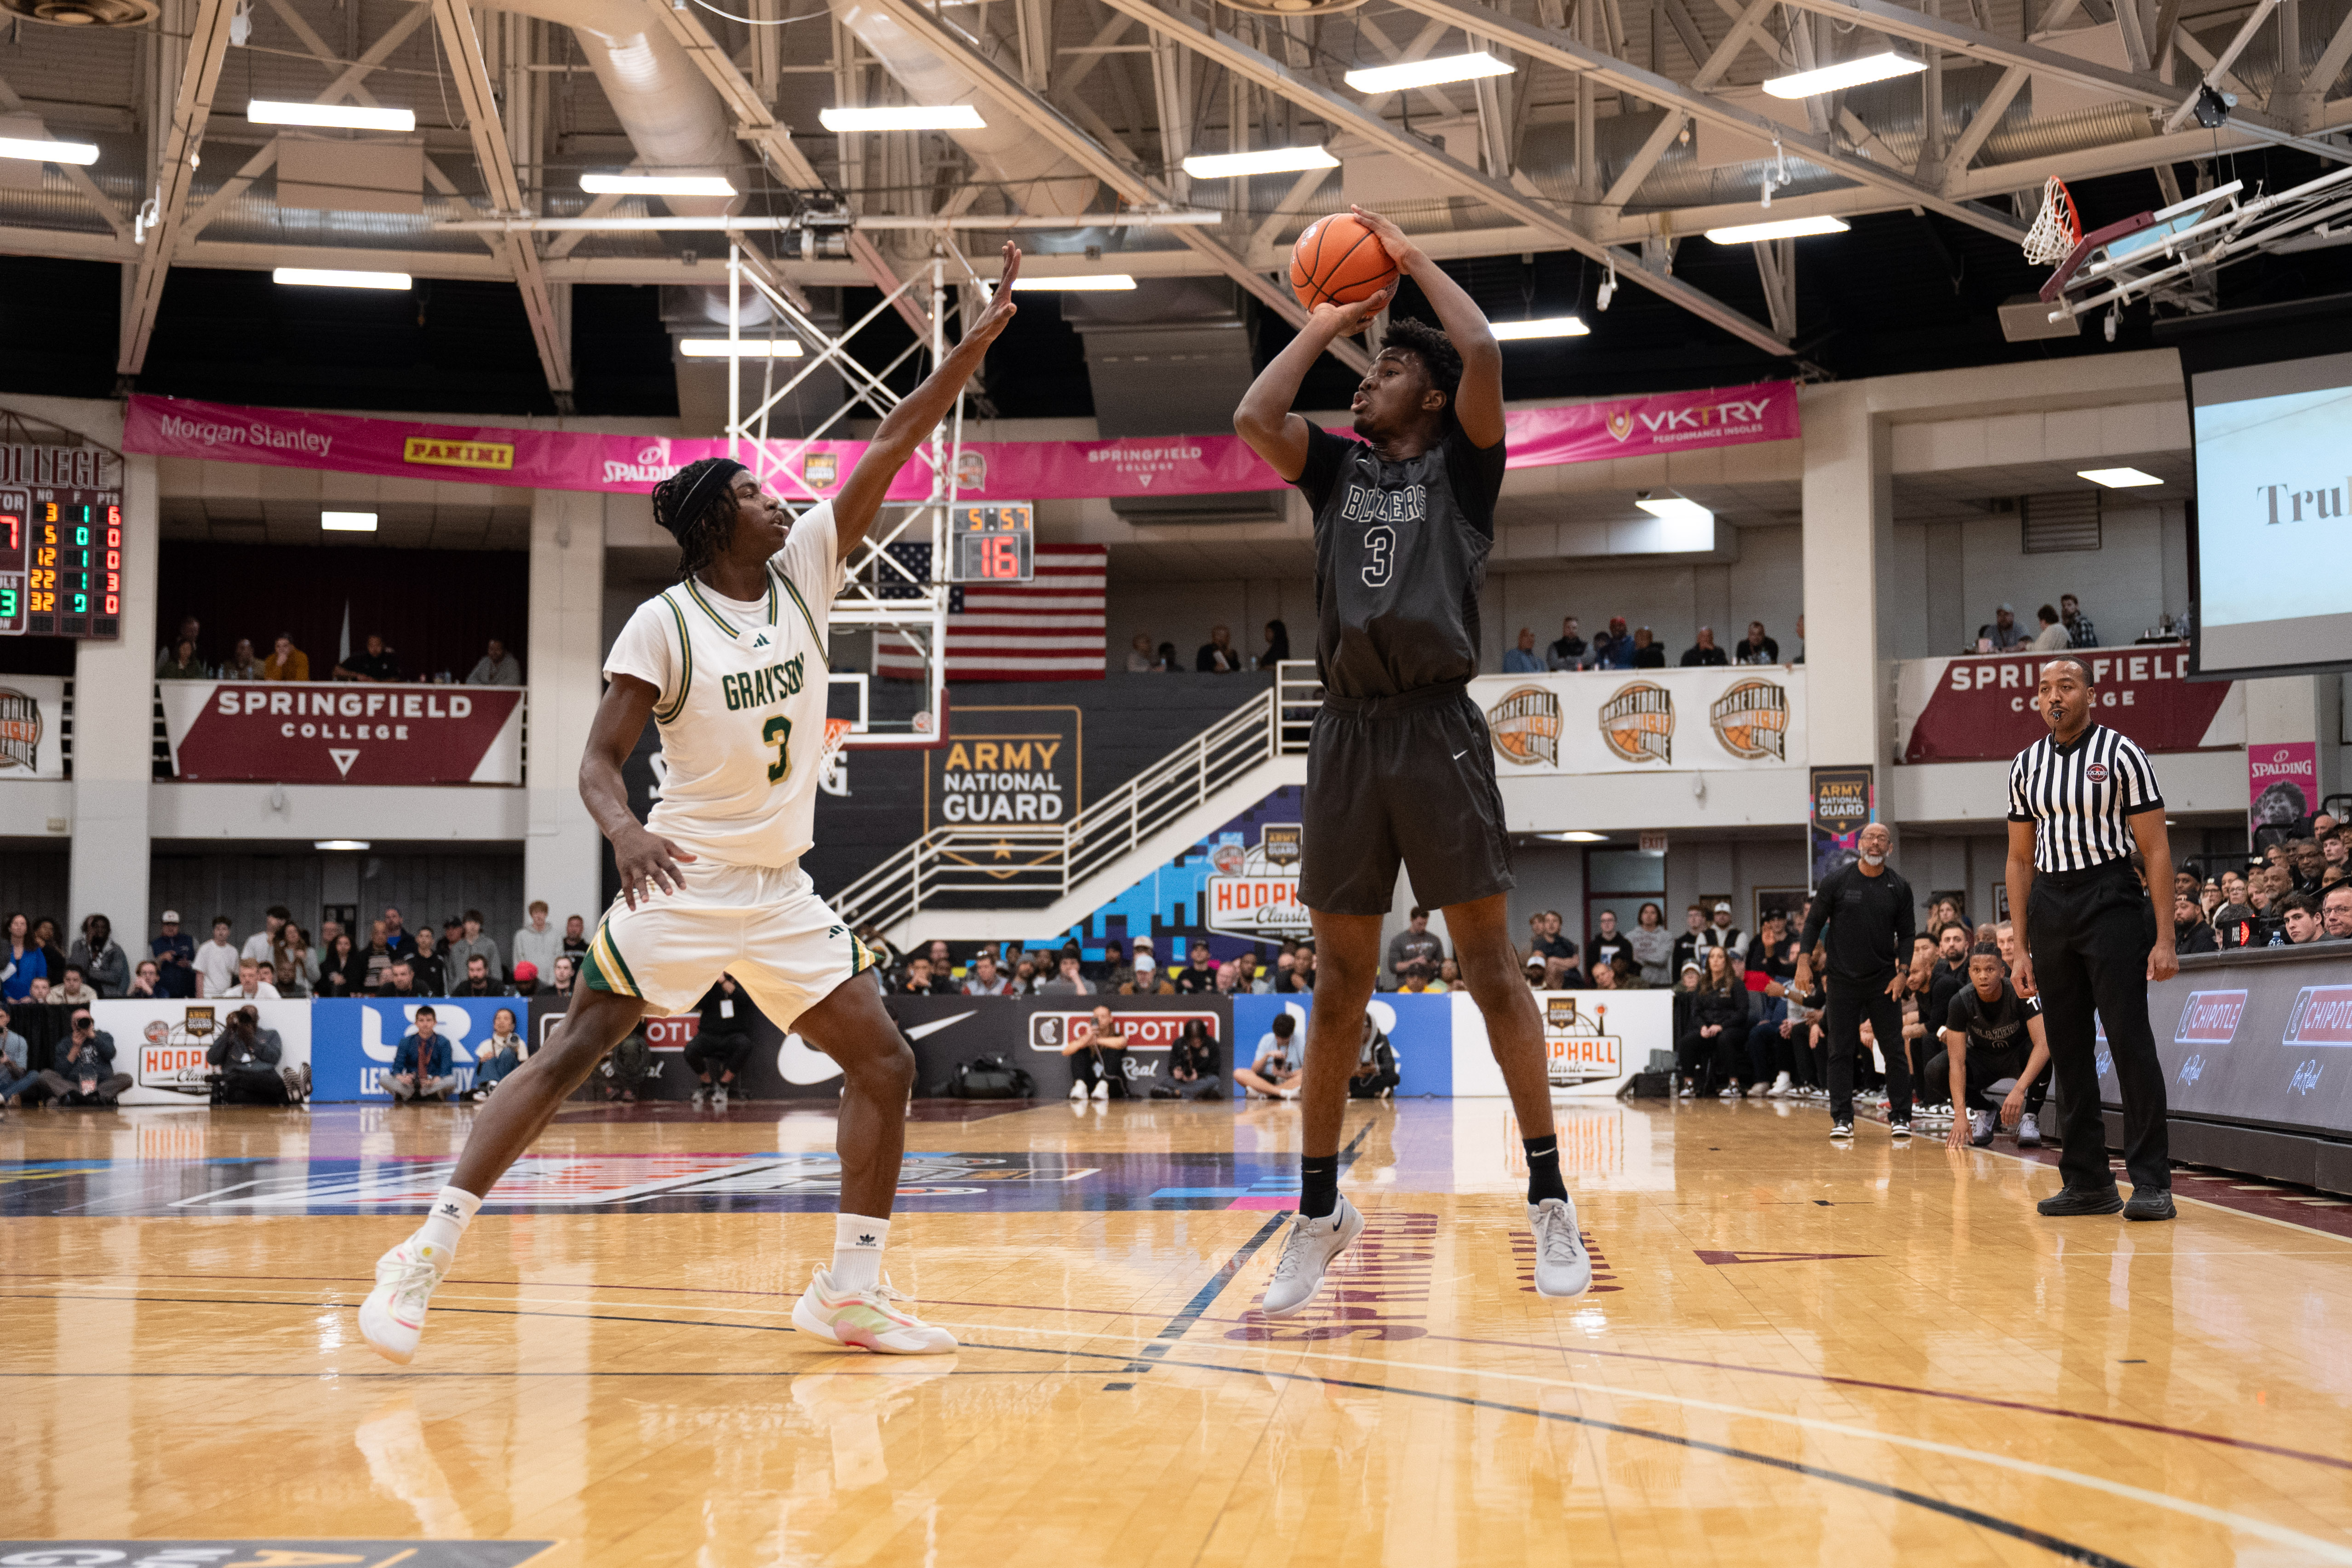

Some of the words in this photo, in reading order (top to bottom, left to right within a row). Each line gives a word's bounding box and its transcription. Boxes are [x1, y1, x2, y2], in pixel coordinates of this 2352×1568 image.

[1639, 398, 1770, 431] VKTRY
[161, 414, 246, 445] Morgan
[250, 424, 332, 457] Stanley
[1724, 424, 1763, 435] INSOLES
[414, 444, 506, 464] PANINI
[1088, 447, 1202, 462] SPRINGFIELD
[603, 460, 681, 483] SPALDIN
[37, 489, 53, 502] NO
[74, 492, 80, 502] F
[46, 503, 58, 522] 3
[84, 505, 89, 523] 1
[108, 506, 121, 526] 6
[45, 525, 57, 544] 5
[76, 526, 89, 546] 0
[107, 528, 120, 548] 0
[38, 547, 57, 567] 12
[82, 550, 88, 567] 1
[106, 550, 120, 570] 0
[981, 536, 1018, 578] 16
[1362, 525, 1396, 587] 3
[30, 569, 56, 589] 22
[82, 572, 87, 590] 1
[107, 572, 120, 592] 3
[30, 592, 55, 611] 32
[105, 595, 119, 614] 0
[722, 651, 804, 711] GRAYSON
[1951, 654, 2188, 690] SPRIFIEL
[218, 691, 472, 718] SPRINGFIELD
[1490, 693, 1554, 726] BASKETBALL
[1603, 690, 1669, 723] BASKETBALL
[1715, 686, 1782, 719] BASKETBALL
[281, 722, 409, 740] COLLEGE
[761, 714, 793, 787] 3
[945, 742, 1061, 770] ARMY
[2252, 760, 2312, 778] SPALDING
[944, 773, 1062, 791] NATIONAL
[1820, 785, 1862, 796] ARMY
[943, 794, 1063, 822] GUARD
[1820, 805, 1865, 816] GUARD
[1218, 883, 1303, 911] HOOPH
[2192, 1004, 2241, 1029] CHIPOTLE
[1546, 1042, 1616, 1064] PHALL
[1122, 1057, 1159, 1081] Real
